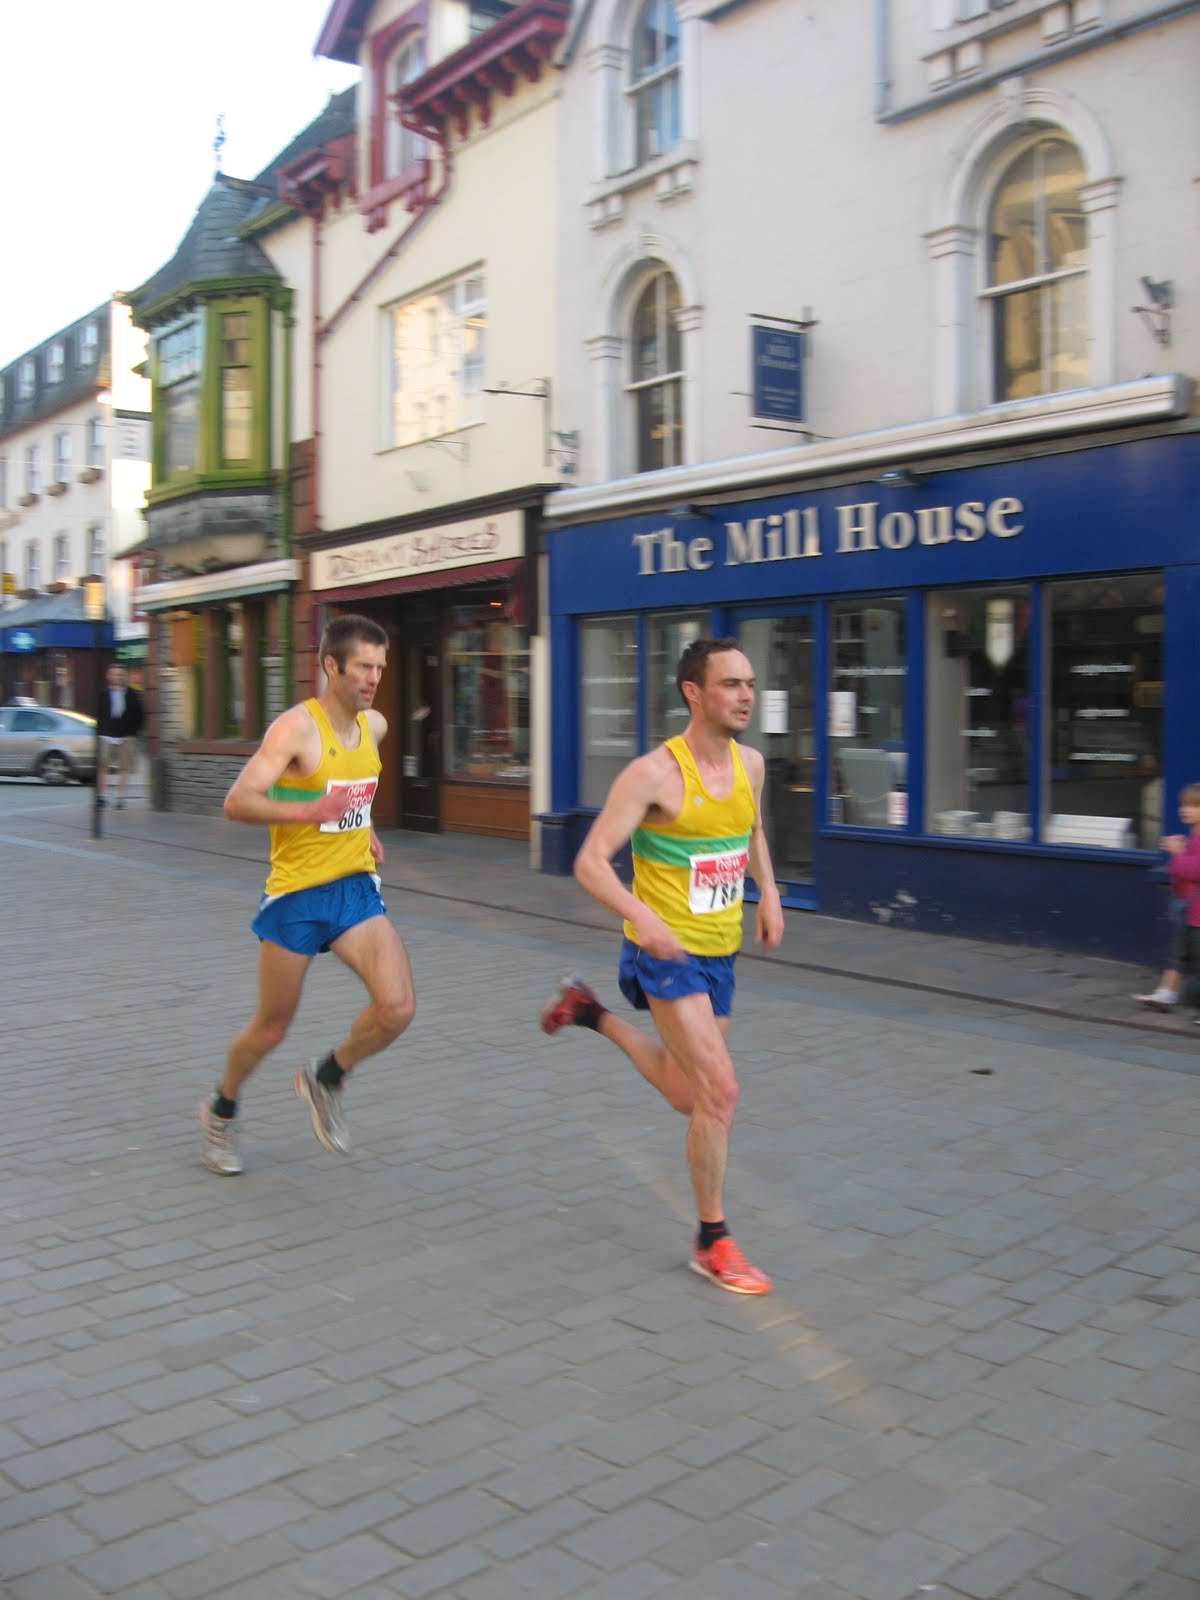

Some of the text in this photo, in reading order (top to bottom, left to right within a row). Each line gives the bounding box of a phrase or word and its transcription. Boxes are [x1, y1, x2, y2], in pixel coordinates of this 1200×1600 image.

[633, 497, 1025, 575] The Mill House
[339, 807, 363, 829] 606
